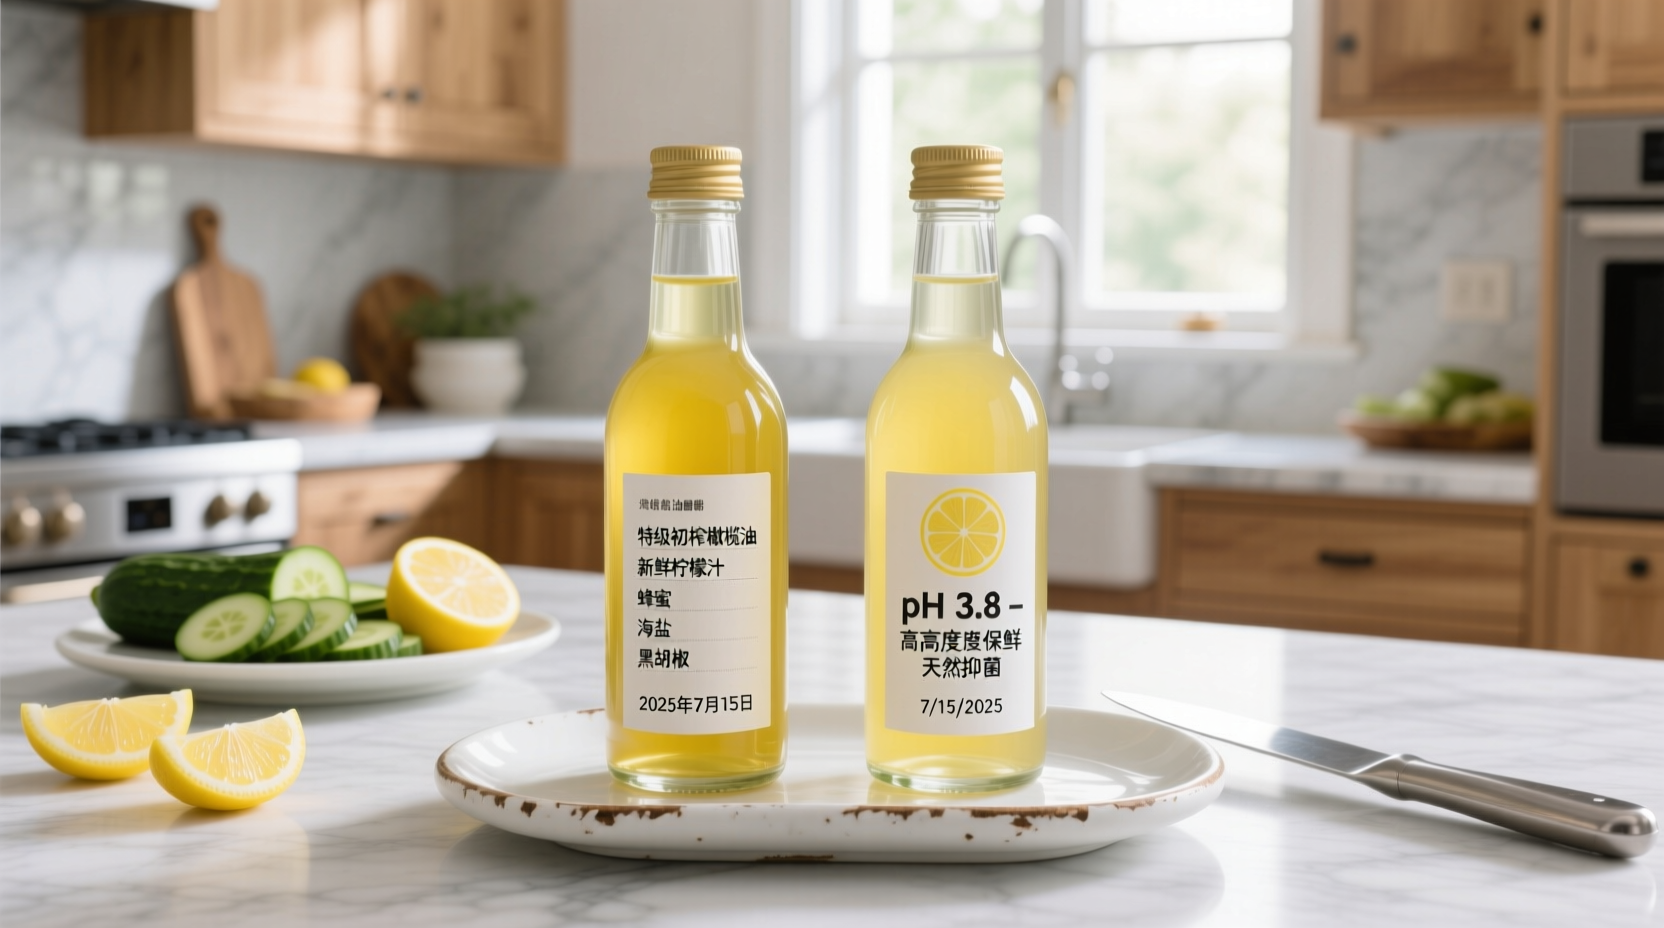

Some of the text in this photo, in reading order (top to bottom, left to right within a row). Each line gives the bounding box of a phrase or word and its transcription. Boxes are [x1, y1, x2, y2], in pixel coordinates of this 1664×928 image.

[637, 526, 757, 547] 特级初榨橄榄油
[637, 557, 725, 578] 新鲜柠檬汁
[637, 588, 672, 608] 蜂蜜
[901, 591, 944, 625] pH
[955, 591, 1001, 620] 3.8
[637, 618, 672, 638] 海盐
[637, 648, 690, 669] 黑胡椒
[922, 656, 1001, 679] 天然抑菌
[639, 694, 753, 714] 2025年7月15日
[920, 697, 1003, 718] 7/15/2025
